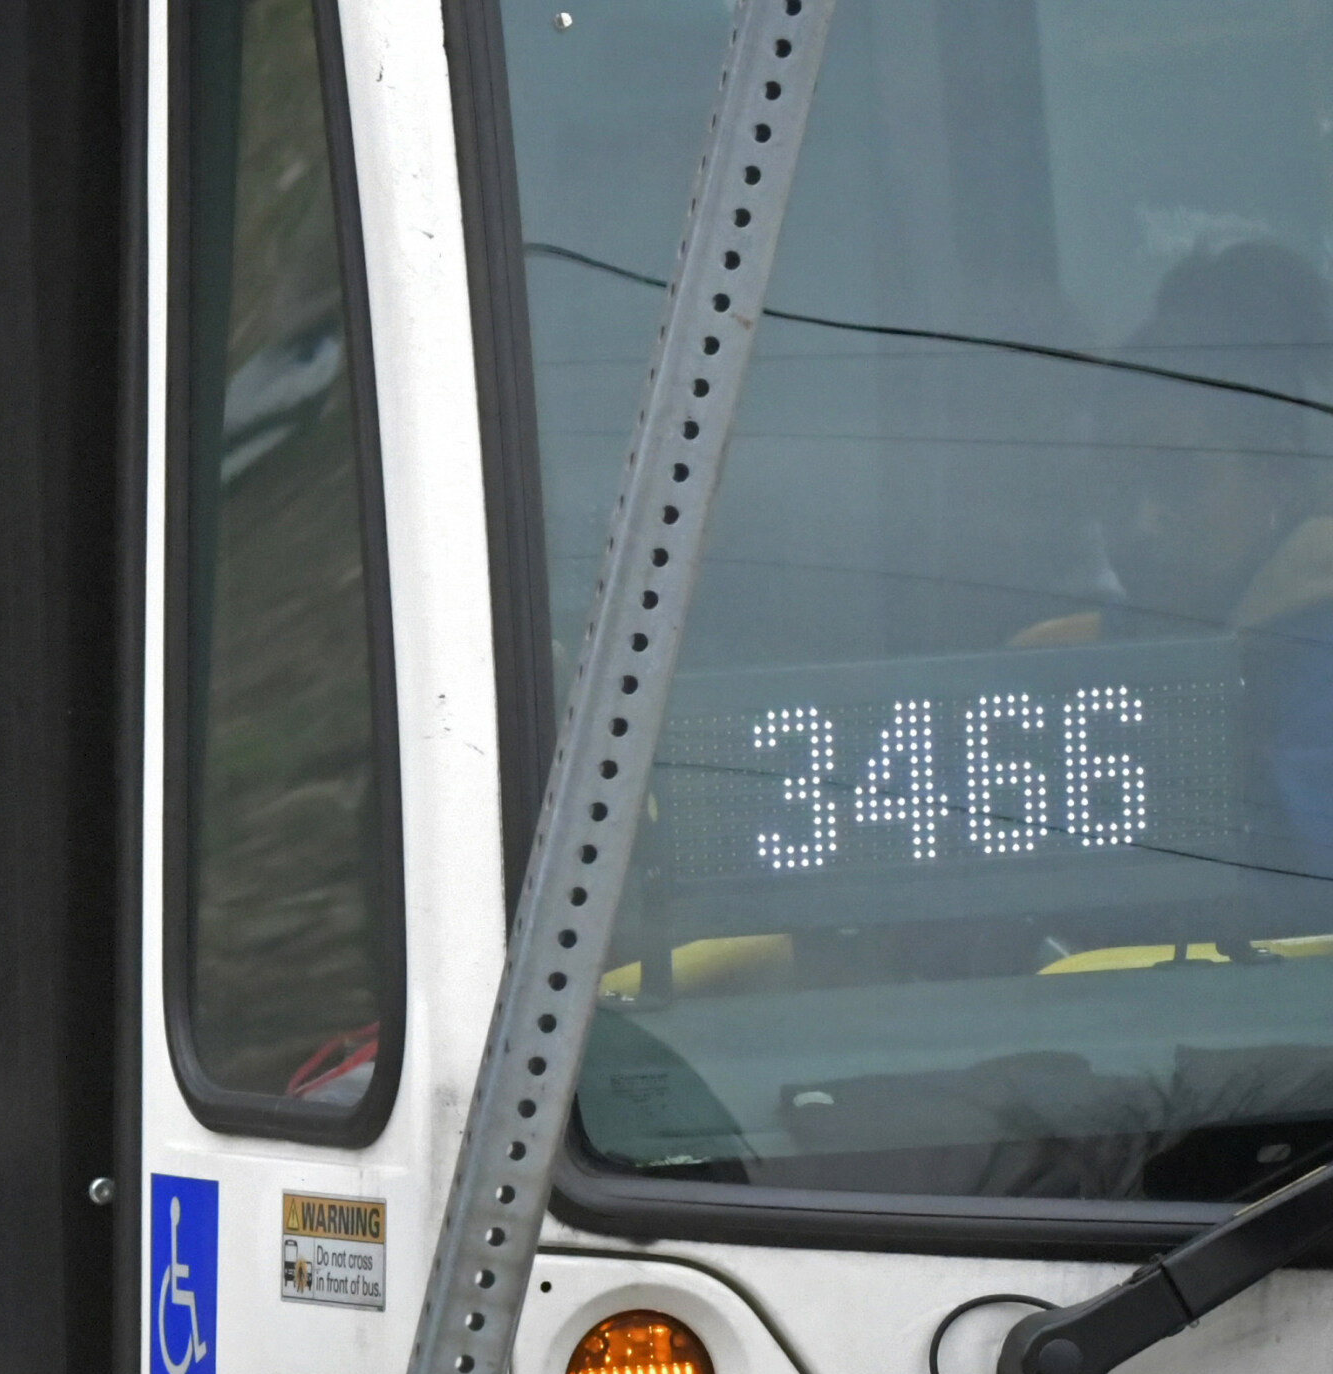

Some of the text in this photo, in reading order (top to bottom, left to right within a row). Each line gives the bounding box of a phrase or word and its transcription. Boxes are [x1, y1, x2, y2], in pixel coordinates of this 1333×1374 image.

[753, 686, 1146, 869] 3466
[301, 1201, 381, 1239] WARNING
[316, 1245, 373, 1271] Do not cross
[316, 1273, 382, 1298] in front of bus.
